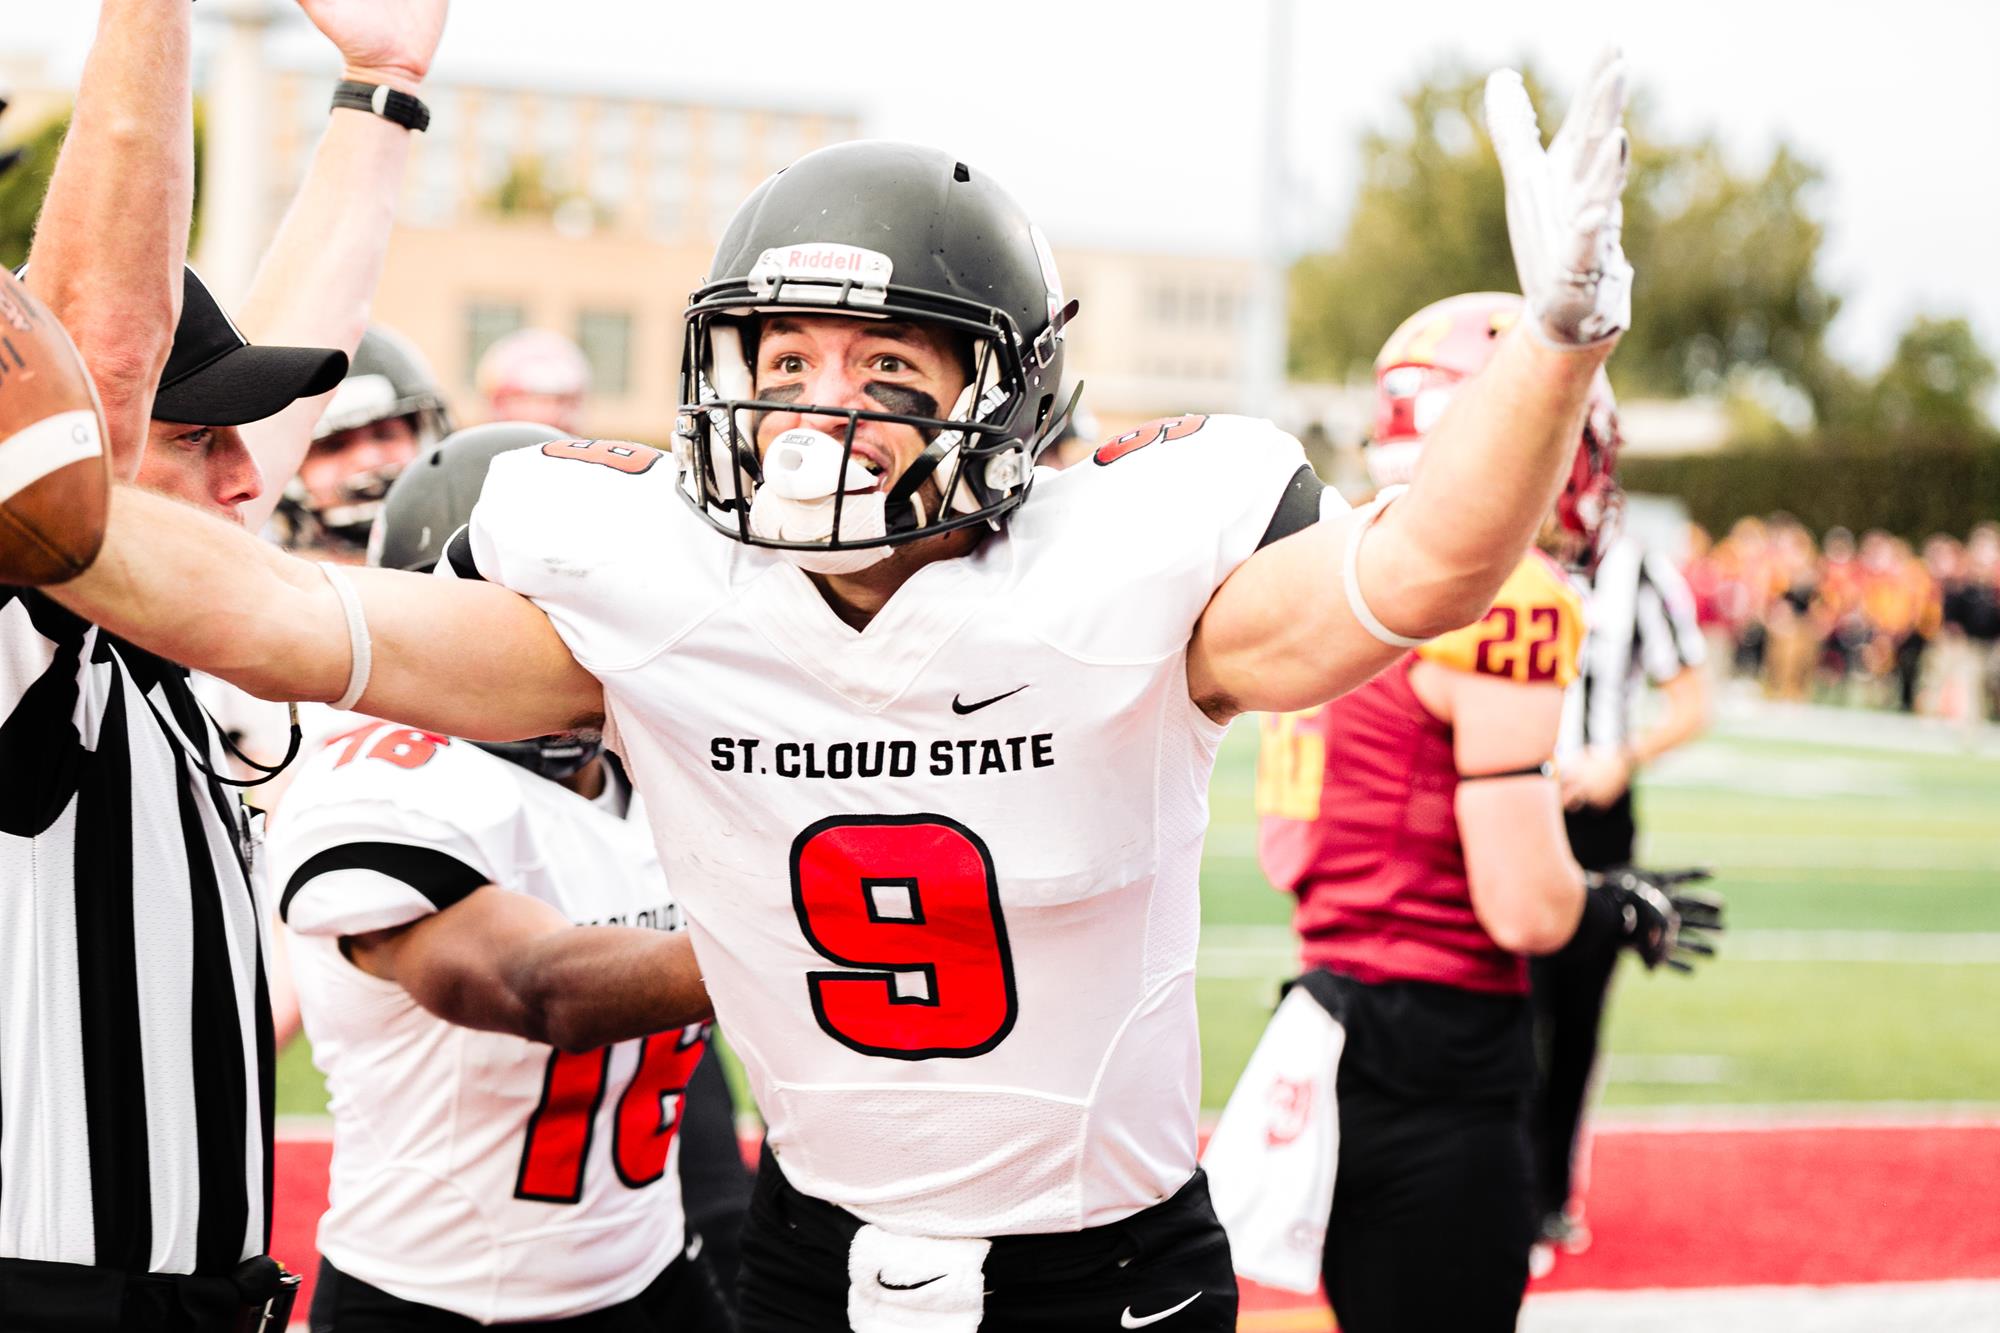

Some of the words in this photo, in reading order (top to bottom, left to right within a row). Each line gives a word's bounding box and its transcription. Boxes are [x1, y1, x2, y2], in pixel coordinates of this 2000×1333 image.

[788, 250, 862, 272] Riddell
[1475, 606, 1560, 682] 22
[710, 736, 767, 774] ST.
[775, 740, 917, 780] CLOUD
[929, 732, 1055, 777] STATE
[789, 812, 1018, 1061] 9
